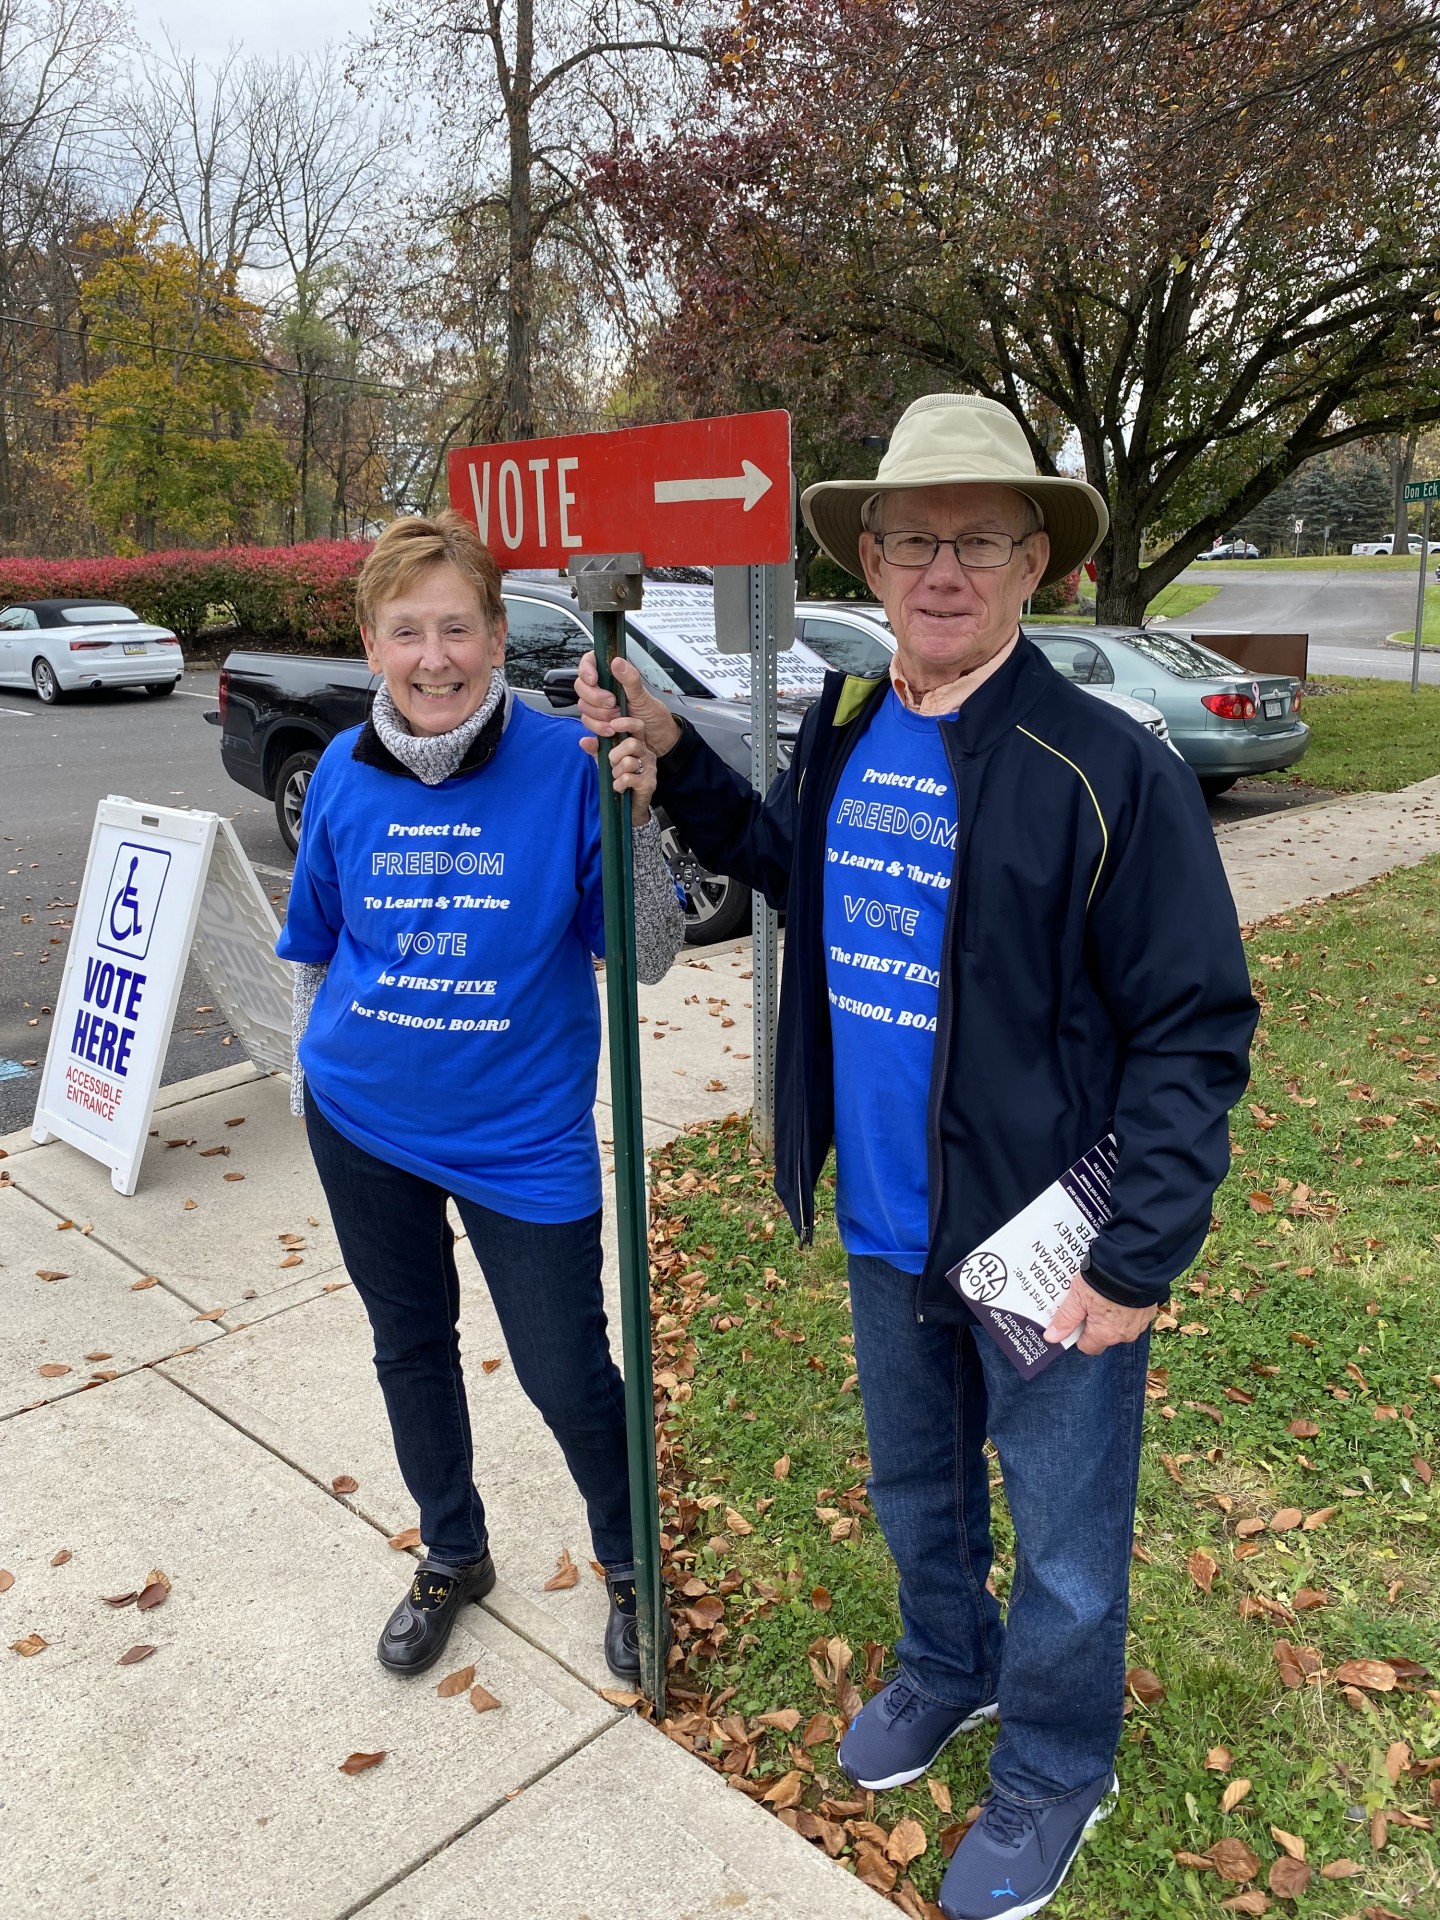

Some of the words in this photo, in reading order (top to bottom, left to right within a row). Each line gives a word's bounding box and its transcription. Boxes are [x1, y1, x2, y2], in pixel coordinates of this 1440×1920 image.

[468, 457, 583, 549] VOTE
[1404, 485, 1420, 499] Don
[1423, 482, 1438, 497] Eck
[642, 599, 695, 608] CHOOL
[705, 655, 750, 667] Paul
[862, 768, 915, 790] Protect
[914, 776, 947, 796] the
[388, 823, 450, 837] Protect
[452, 823, 482, 837] the
[836, 798, 958, 850] FREEDOM
[372, 852, 504, 875] FREEDOM
[839, 851, 884, 872] Learn
[886, 860, 904, 877] &
[907, 864, 951, 889] Thriv
[364, 897, 382, 909] To
[384, 896, 433, 909] Learn
[434, 896, 450, 910] &
[453, 895, 510, 910] Thrive
[843, 895, 920, 937] VOTE
[397, 932, 467, 956] VOTE
[830, 946, 851, 964] The
[852, 953, 907, 976] FIRST
[83, 956, 147, 1021] VOTE
[377, 971, 395, 986] he
[397, 975, 453, 992] FIRST
[454, 980, 497, 995] FIVE
[351, 1000, 375, 1018] For
[376, 1010, 446, 1030] SCHOOL
[448, 1018, 511, 1032] BOARD
[838, 995, 894, 1023] SCHOOL
[70, 1009, 135, 1078] HERE
[65, 1065, 122, 1106] ACCESSIBLE
[66, 1083, 115, 1122] ENTRANCE
[1065, 1184, 1076, 1197] and
[977, 1253, 1006, 1291] 7th
[1030, 1239, 1073, 1291] GEHMAN
[1052, 1242, 1081, 1277] RUSE
[960, 1261, 991, 1301] Nov.
[1010, 1266, 1032, 1292] five:
[1027, 1260, 1061, 1301] TORBA
[1027, 1288, 1047, 1312] first
[988, 1307, 1012, 1335] Lehigh
[1003, 1312, 1023, 1336] Board
[1006, 1331, 1034, 1366] Southern
[1019, 1333, 1041, 1360] School
[1023, 1324, 1048, 1354] Election
